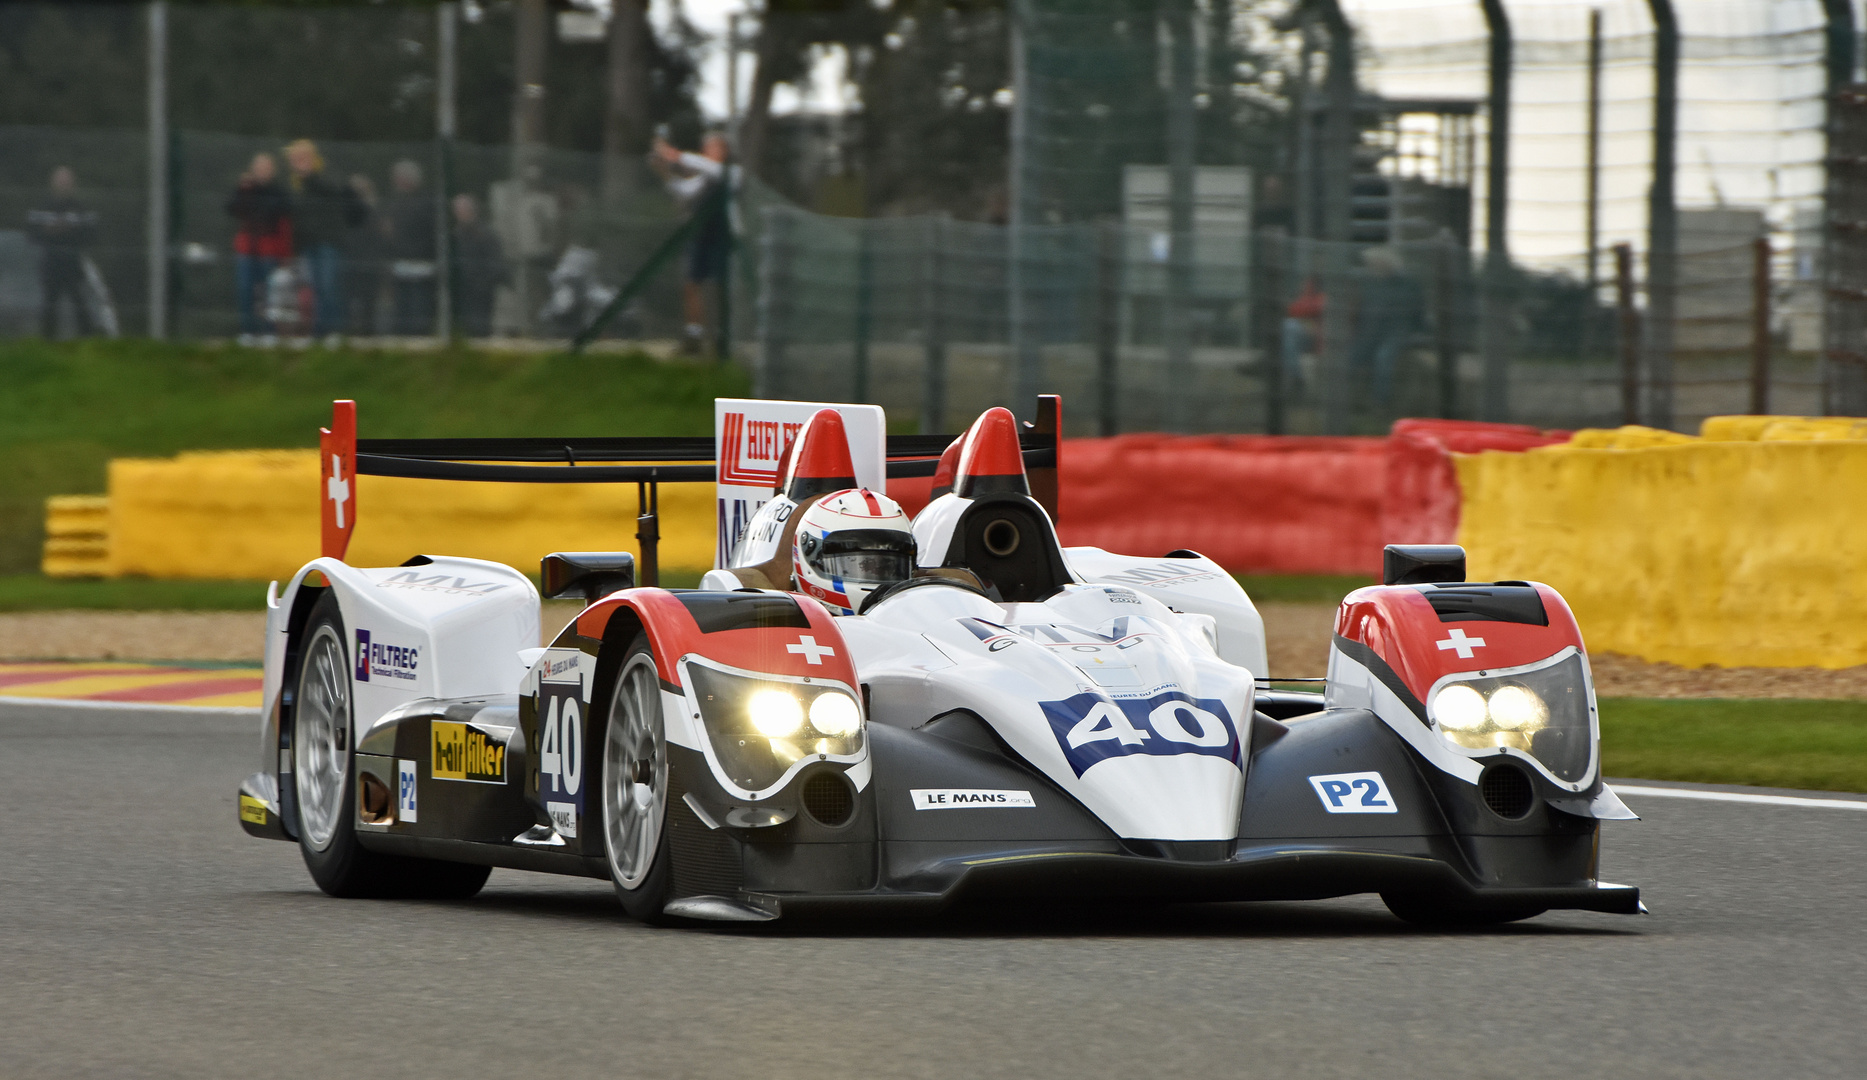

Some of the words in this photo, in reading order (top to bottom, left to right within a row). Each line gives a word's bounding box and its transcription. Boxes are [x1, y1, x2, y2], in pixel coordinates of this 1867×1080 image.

[747, 420, 779, 461] HIFI
[387, 571, 509, 593] MVI
[372, 642, 418, 670] FILTREC
[543, 659, 552, 678] 24
[371, 665, 392, 677] Technical
[394, 669, 417, 681] Filtration
[1153, 683, 1178, 693] MANS
[1066, 700, 1230, 750] 40
[435, 730, 463, 773] h-air
[466, 731, 504, 776] filter
[541, 695, 582, 795] 40
[401, 772, 416, 811] P2
[926, 793, 947, 804] LE
[1319, 778, 1390, 808] P2
